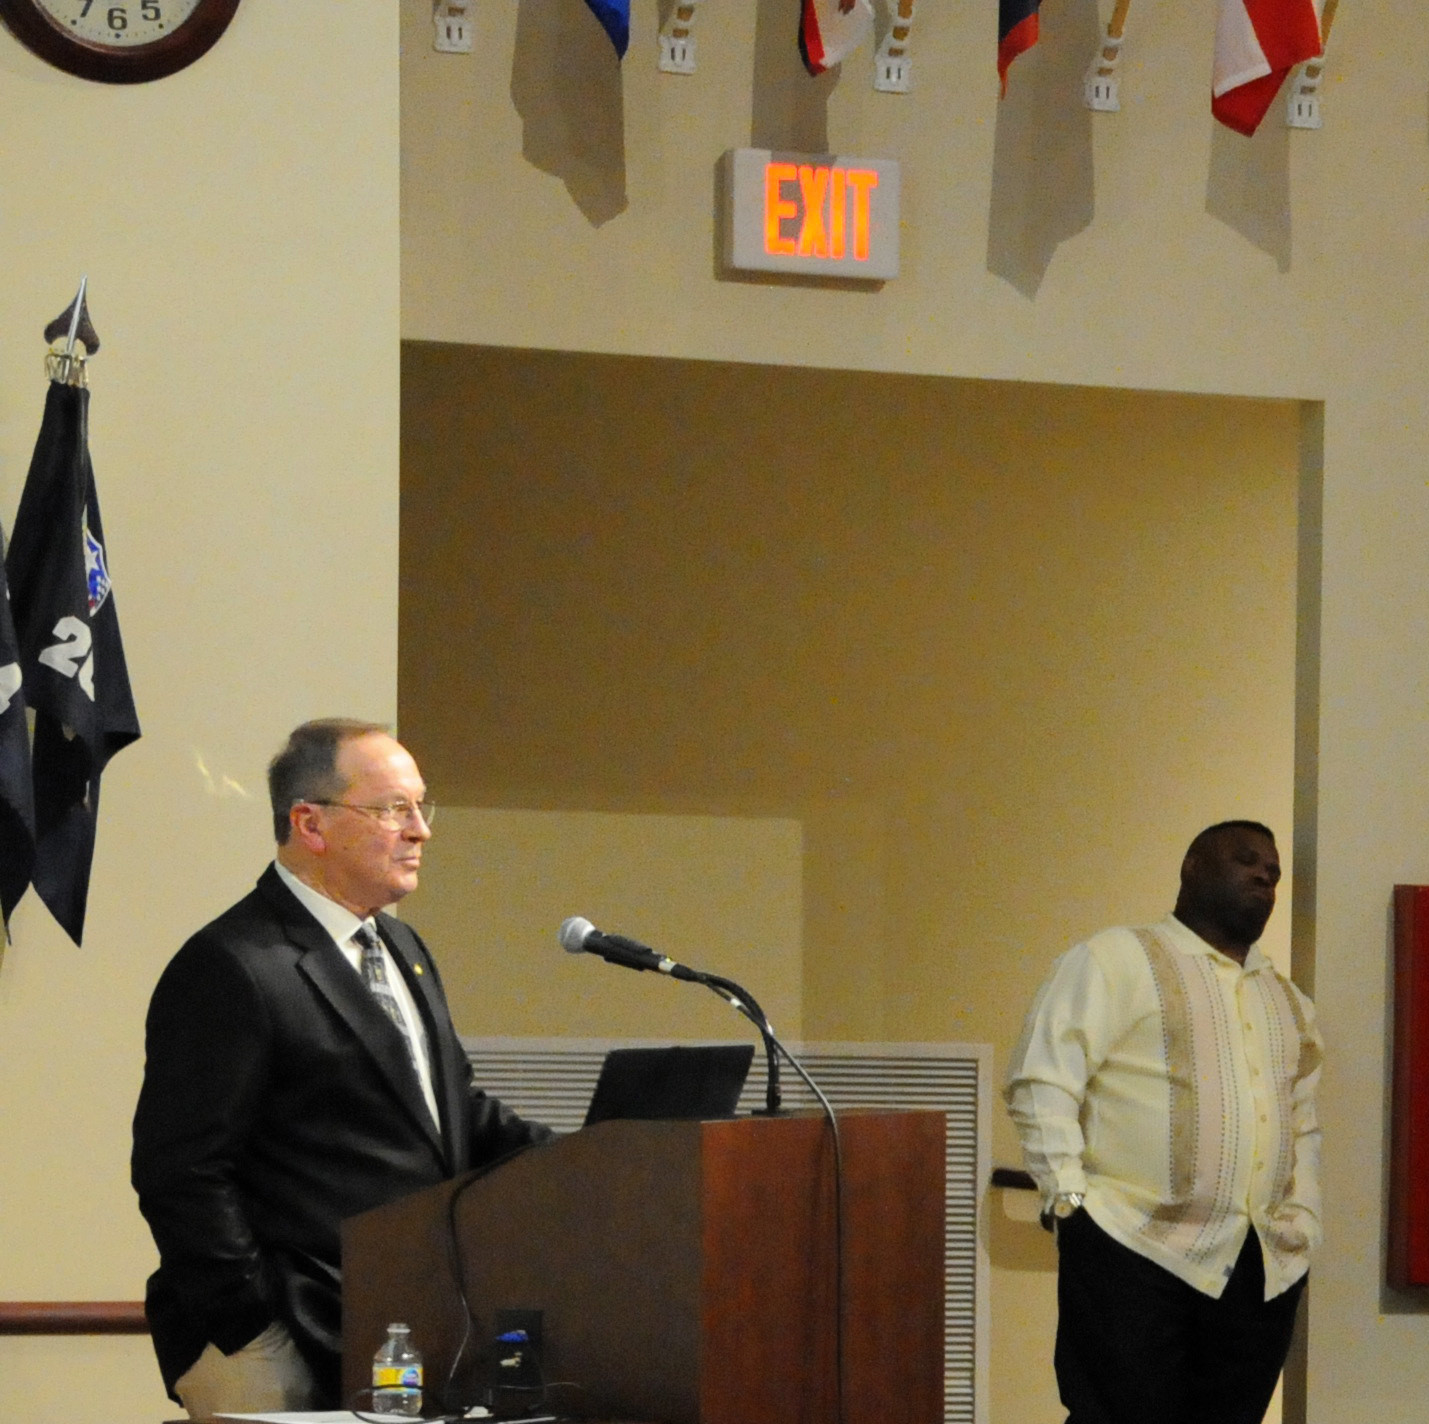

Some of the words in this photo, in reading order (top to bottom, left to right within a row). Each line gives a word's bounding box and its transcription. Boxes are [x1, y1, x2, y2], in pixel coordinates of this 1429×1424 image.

[107, 7, 128, 31] 6
[141, 0, 162, 21] 5
[764, 162, 880, 262] EXIT
